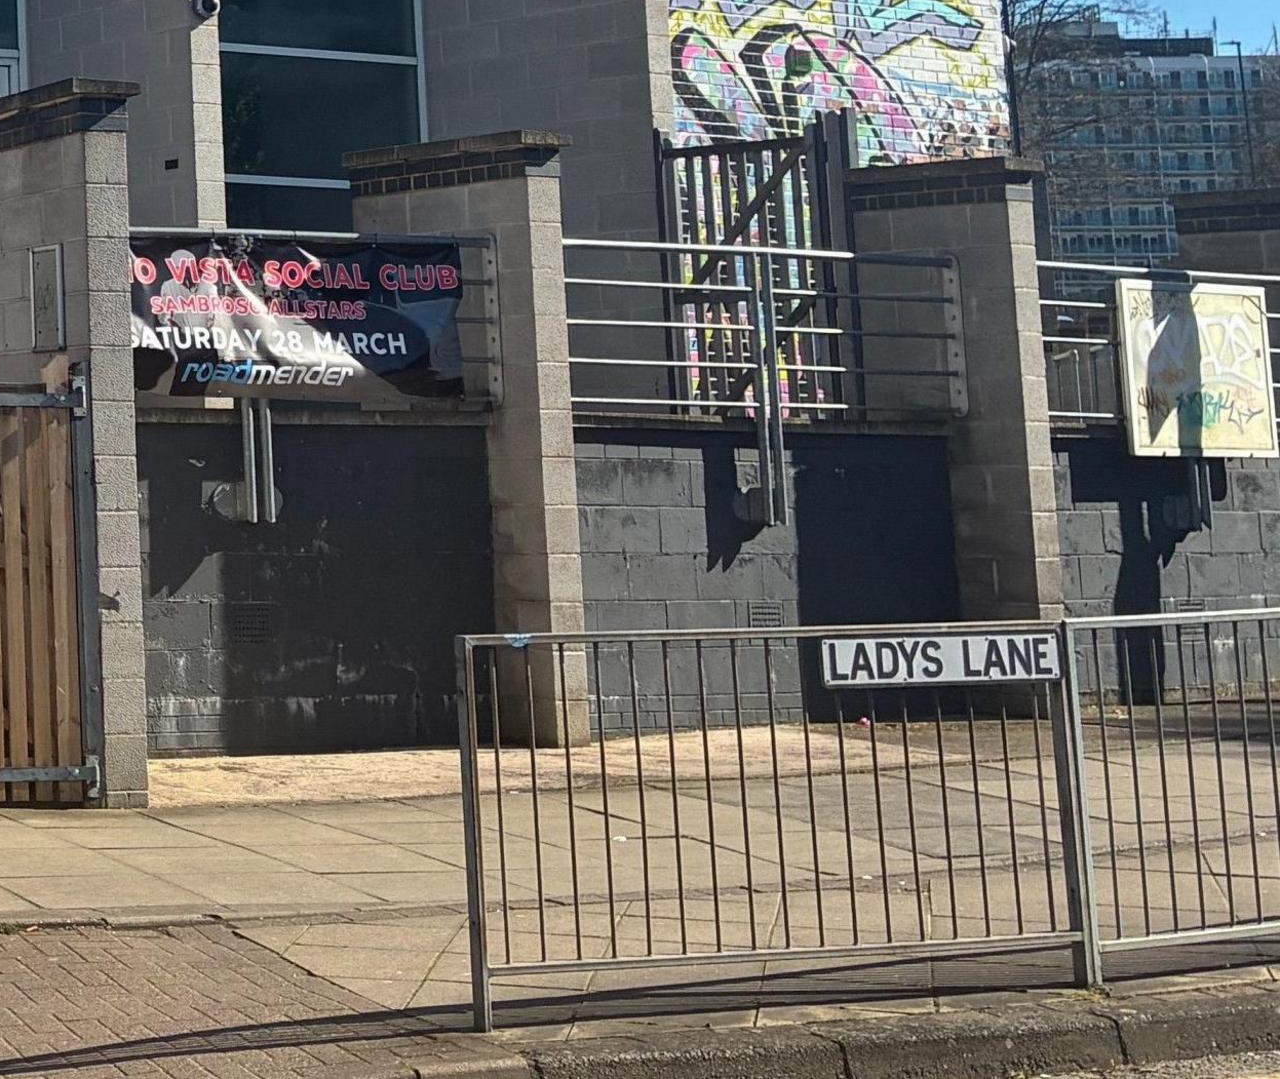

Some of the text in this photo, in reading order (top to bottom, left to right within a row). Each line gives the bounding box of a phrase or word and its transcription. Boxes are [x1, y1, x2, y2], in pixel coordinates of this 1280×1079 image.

[164, 257, 256, 287] VISTA
[263, 260, 370, 290] SOCIAL
[378, 263, 459, 291] CLUB
[268, 298, 368, 320] ALLSTARS
[131, 325, 408, 355] SATURDAY 28 MARCH
[180, 358, 355, 387] roadmender
[827, 636, 1053, 681] LADYS LANE
